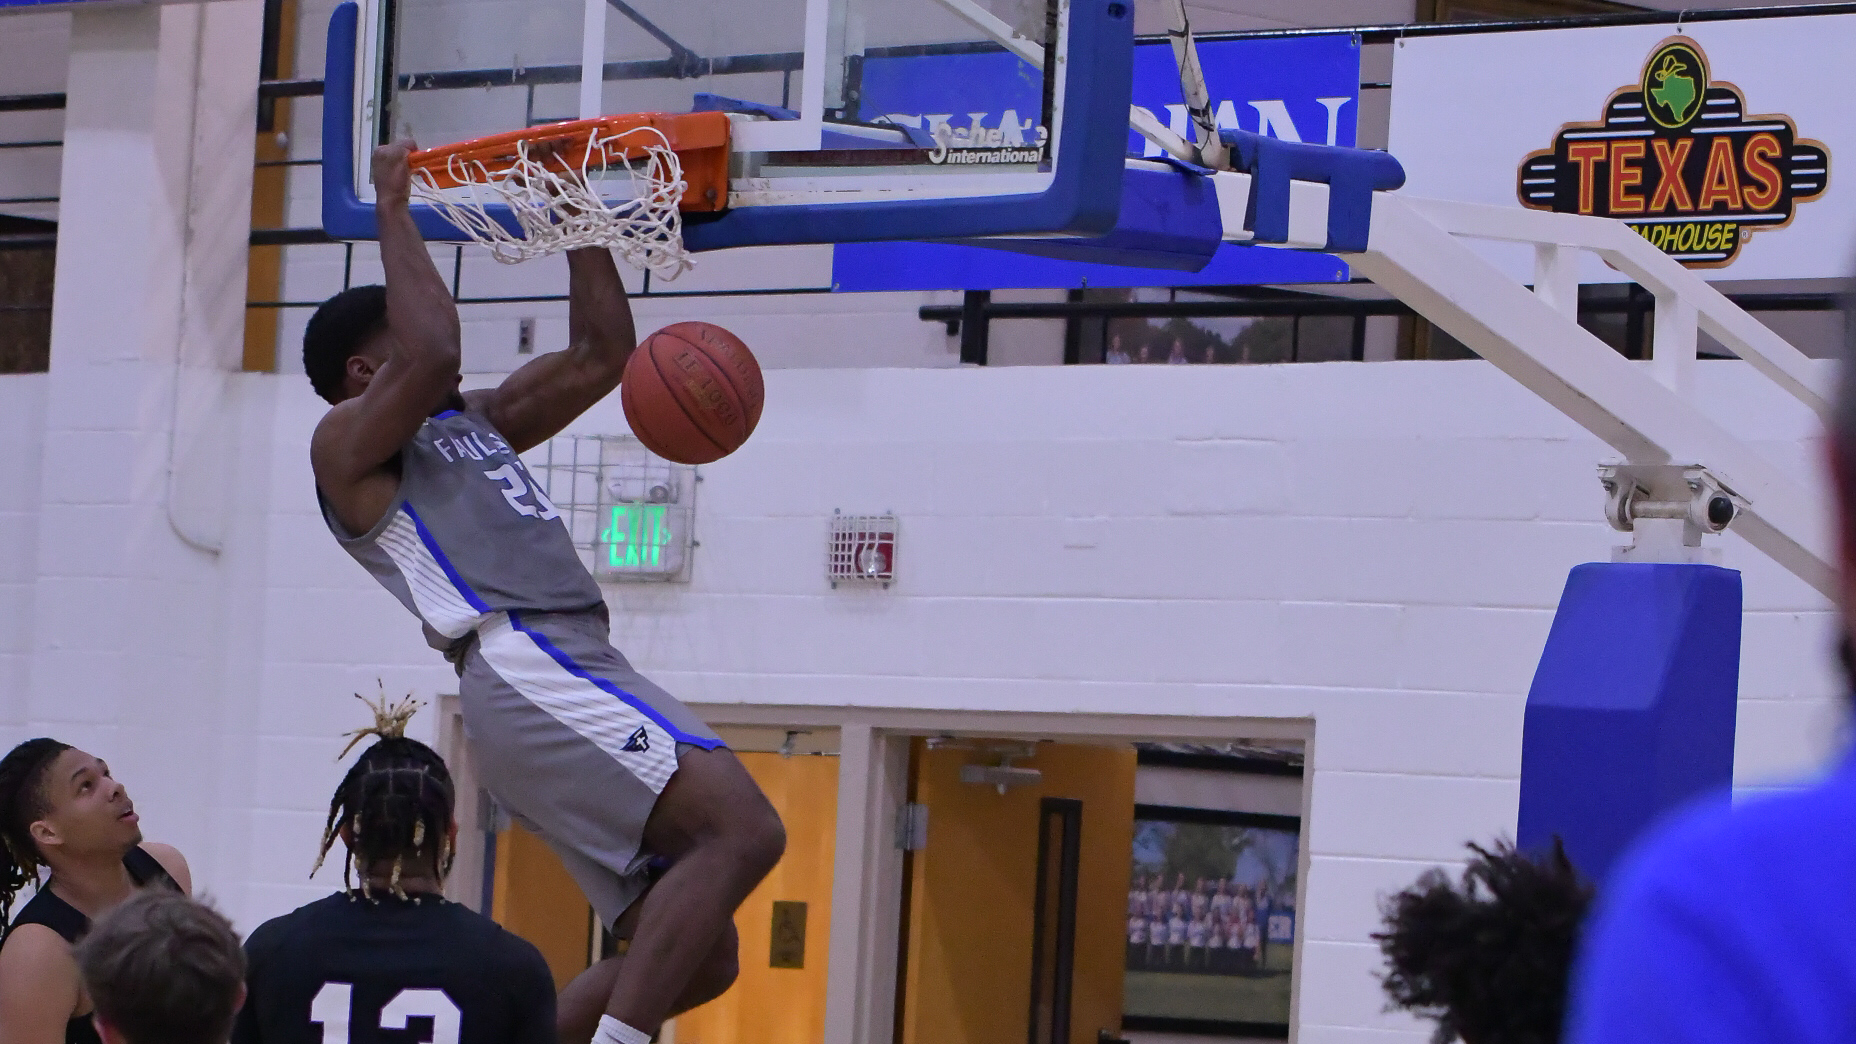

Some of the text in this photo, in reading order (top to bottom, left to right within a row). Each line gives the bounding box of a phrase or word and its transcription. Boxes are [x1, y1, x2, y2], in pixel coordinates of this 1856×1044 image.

[947, 148, 1044, 164] international
[1567, 131, 1784, 215] TEXAS
[1629, 223, 1738, 251] ADHOUSE
[608, 505, 666, 567] EXIT
